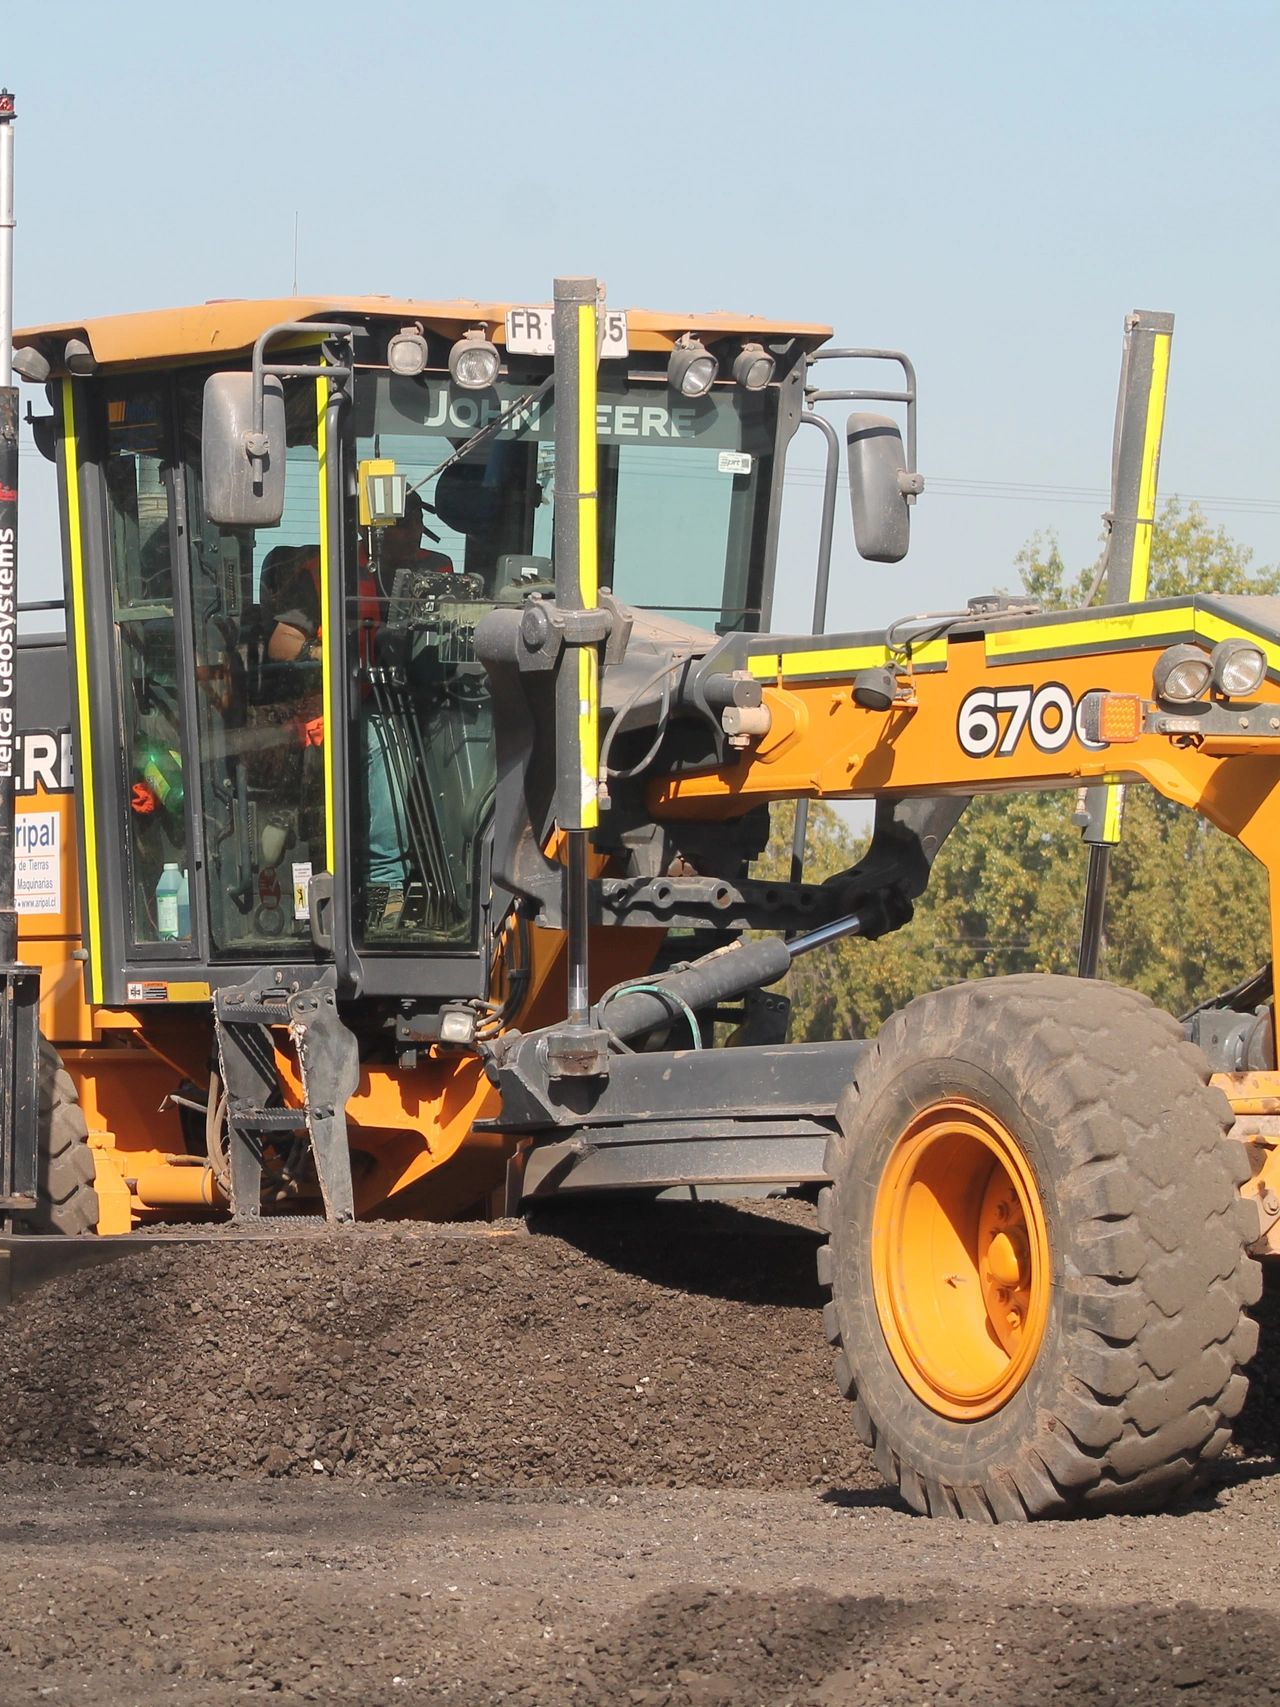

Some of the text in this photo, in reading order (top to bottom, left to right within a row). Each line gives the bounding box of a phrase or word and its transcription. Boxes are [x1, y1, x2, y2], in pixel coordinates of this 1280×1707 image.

[511, 311, 542, 340] FR
[424, 390, 696, 438] JOHN EERE
[15, 816, 55, 853] ripal
[29, 859, 49, 871] Tierras
